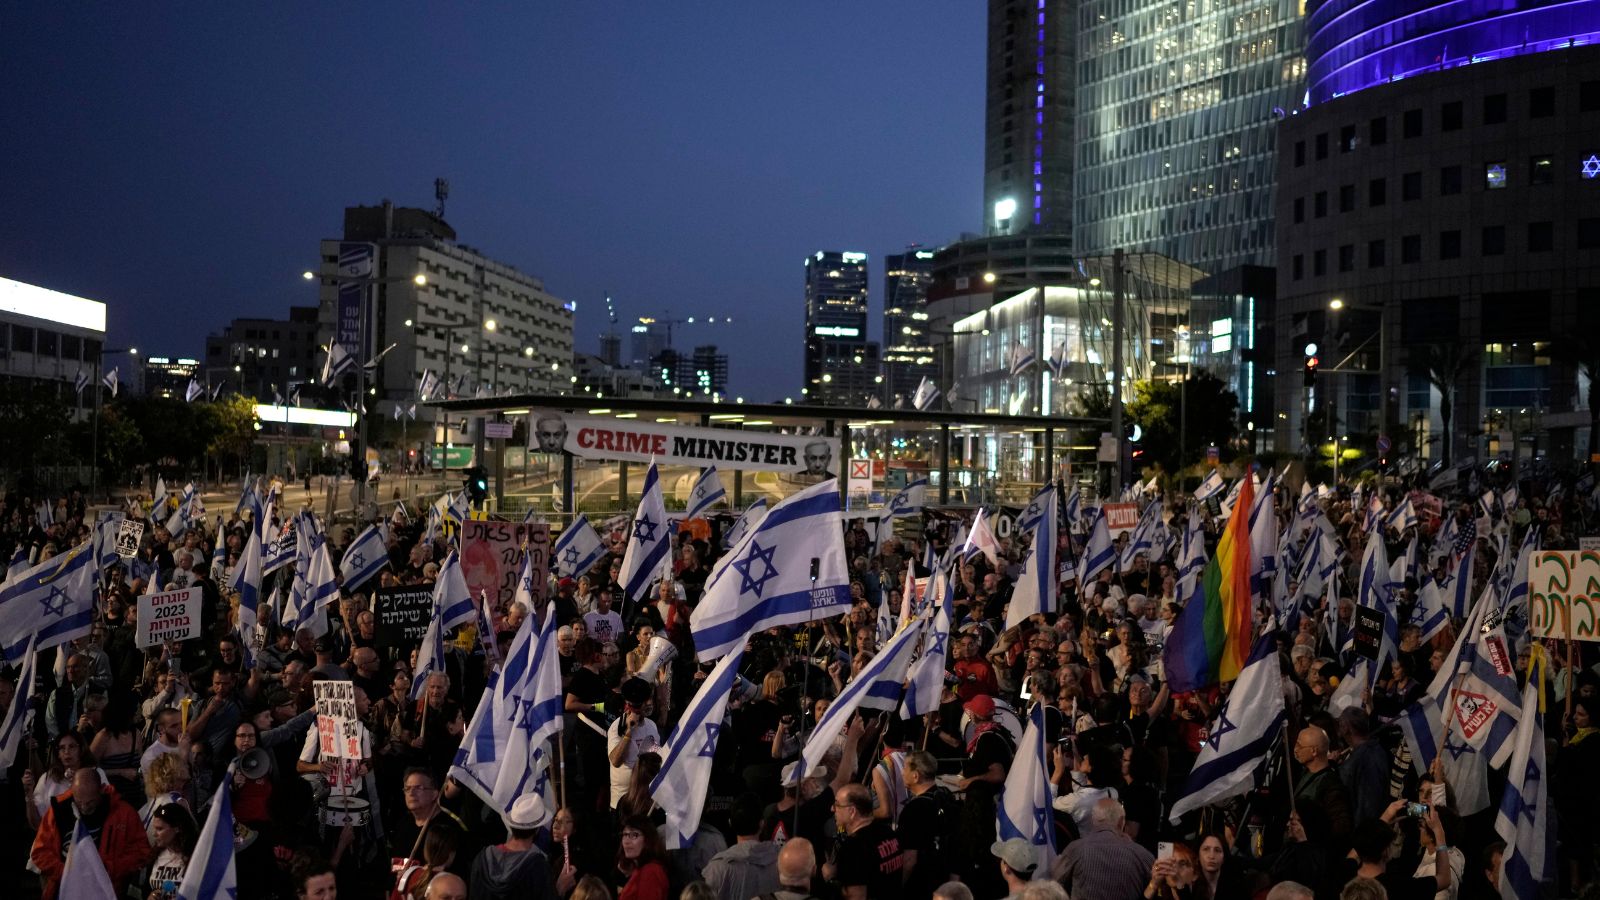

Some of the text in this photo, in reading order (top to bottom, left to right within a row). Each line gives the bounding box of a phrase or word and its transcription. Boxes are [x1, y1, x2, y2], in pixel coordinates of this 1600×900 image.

[576, 427, 798, 466] CRIME MINISTER
[151, 591, 190, 606] פוגרום
[155, 603, 186, 619] 2023
[382, 608, 421, 625] שינתה
[150, 616, 191, 631] בחירות
[149, 627, 190, 644] עכשיו!
[1462, 709, 1487, 733] כשיר
